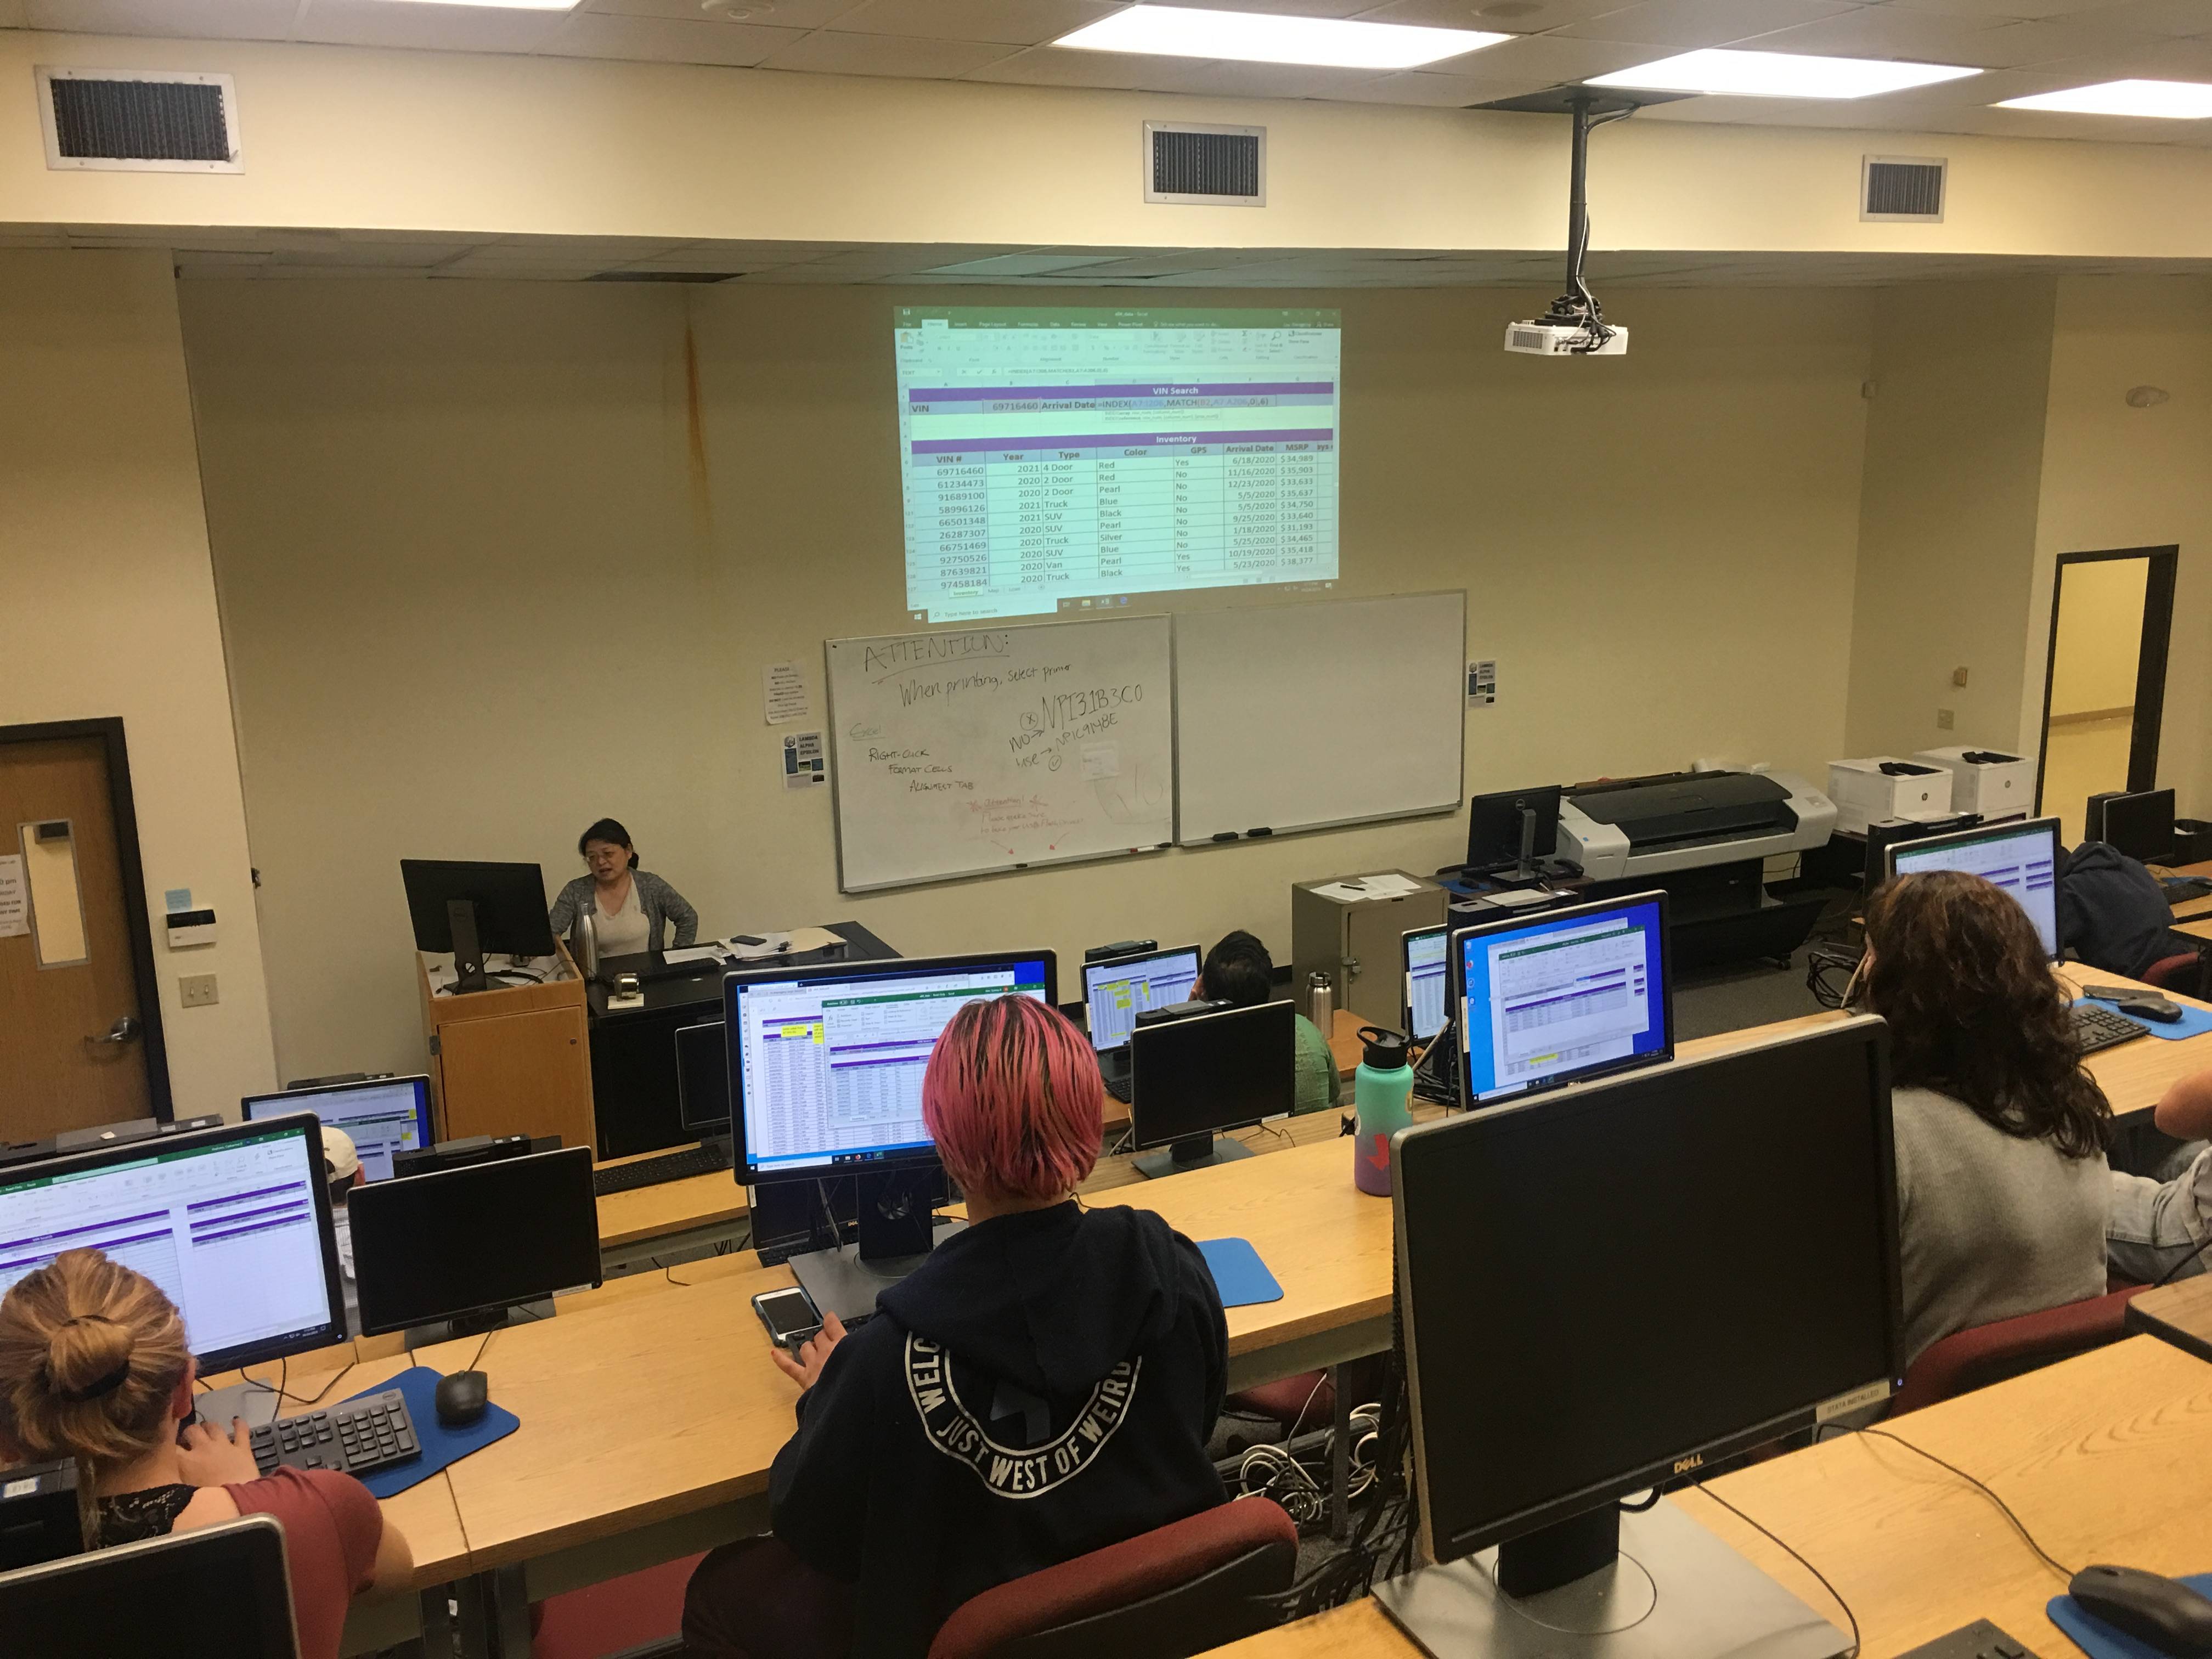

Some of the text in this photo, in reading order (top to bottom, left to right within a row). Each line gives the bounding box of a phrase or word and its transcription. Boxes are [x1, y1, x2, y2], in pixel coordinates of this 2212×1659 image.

[992, 403, 1038, 411] 69716460
[1042, 402, 1072, 410] Arrival
[1124, 448, 1147, 456] Color
[1226, 444, 1253, 453] Arrival
[1255, 444, 1274, 452] Date
[1156, 435, 1197, 444] Inventory
[937, 467, 984, 476] 69716460
[1232, 456, 1275, 464] 6/18/2020
[938, 480, 984, 488] 61234473
[1099, 473, 1115, 481] Red
[1228, 467, 1275, 476] 11/16/2020
[938, 492, 985, 501] 91689100
[1099, 485, 1120, 493] Pearl
[1228, 479, 1275, 488] 12/23/2020
[939, 505, 985, 514] 58996126
[1099, 497, 1118, 505] Blue
[1238, 490, 1275, 499] 5/5/2020
[939, 517, 985, 526] 66501348
[1100, 509, 1121, 517] Black
[1238, 502, 1275, 511] 5/5/2020
[939, 529, 986, 539] 26287307
[1100, 521, 1121, 529] Pearl
[1233, 514, 1275, 522] 9/25/2020
[940, 542, 986, 551] 66751469
[1046, 537, 1069, 545] Truck
[1100, 533, 1122, 541] Silver
[1233, 524, 1275, 534] 1/18/2020
[940, 554, 987, 564] 92750526
[1101, 545, 1119, 553] Blue
[1233, 536, 1275, 545] 5/25/2020
[940, 567, 986, 576] 87639821
[1101, 557, 1121, 565] Pearl
[1229, 548, 1275, 557] 10/19/2020
[941, 579, 988, 589] 97458184
[1101, 569, 1122, 577] Black
[1233, 559, 1275, 568] 5/23/2020
[864, 634, 1008, 672] ATTENTION:
[899, 679, 941, 707] When
[955, 781, 974, 790] TAB
[1826, 1389, 1879, 1414] STATA INSTALLED
[936, 1415, 989, 1464] JUST
[989, 1455, 1048, 1491] WEST
[1054, 1440, 1081, 1475] OF
[1674, 1454, 1703, 1474] DELL
